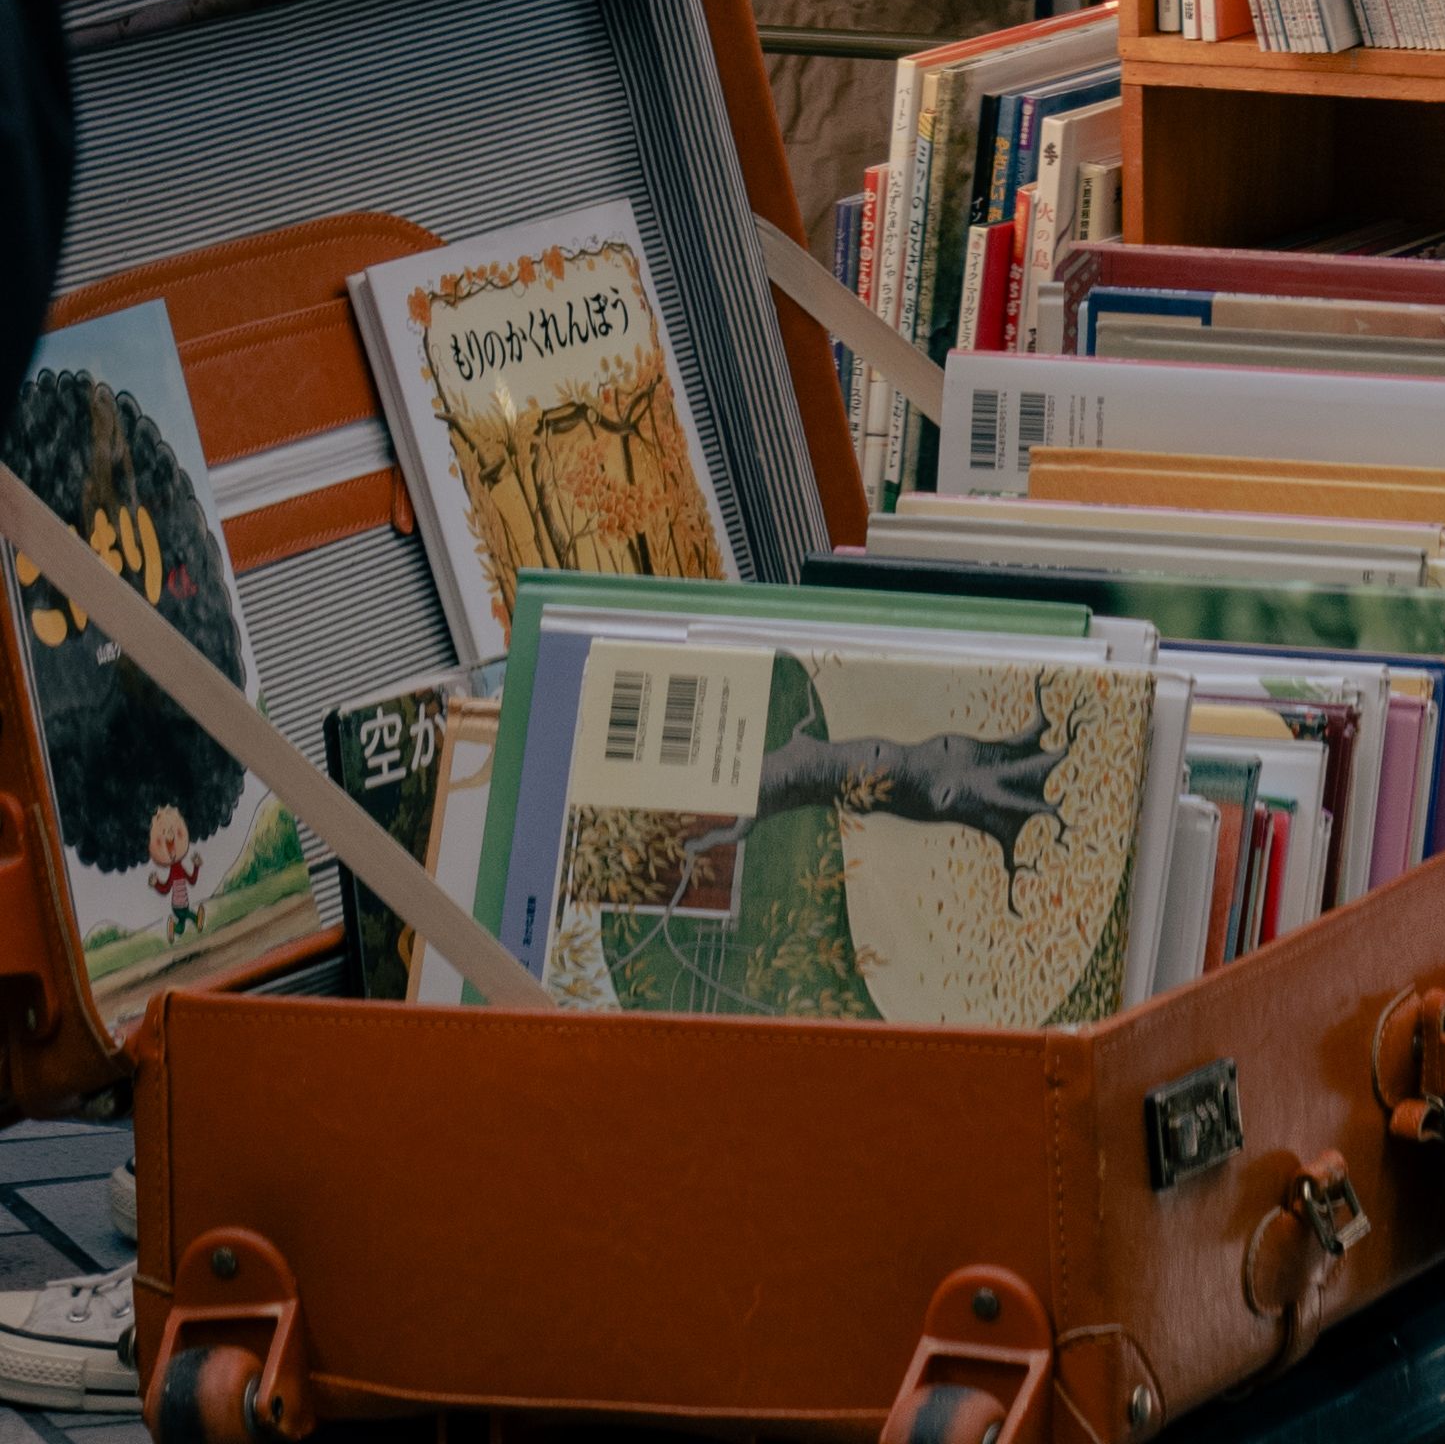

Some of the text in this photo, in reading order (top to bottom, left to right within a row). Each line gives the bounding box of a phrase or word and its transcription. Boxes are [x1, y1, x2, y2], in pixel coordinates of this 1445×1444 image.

[1031, 201, 1056, 272] 火の鳥
[449, 286, 632, 383] もりのかくれんぼう
